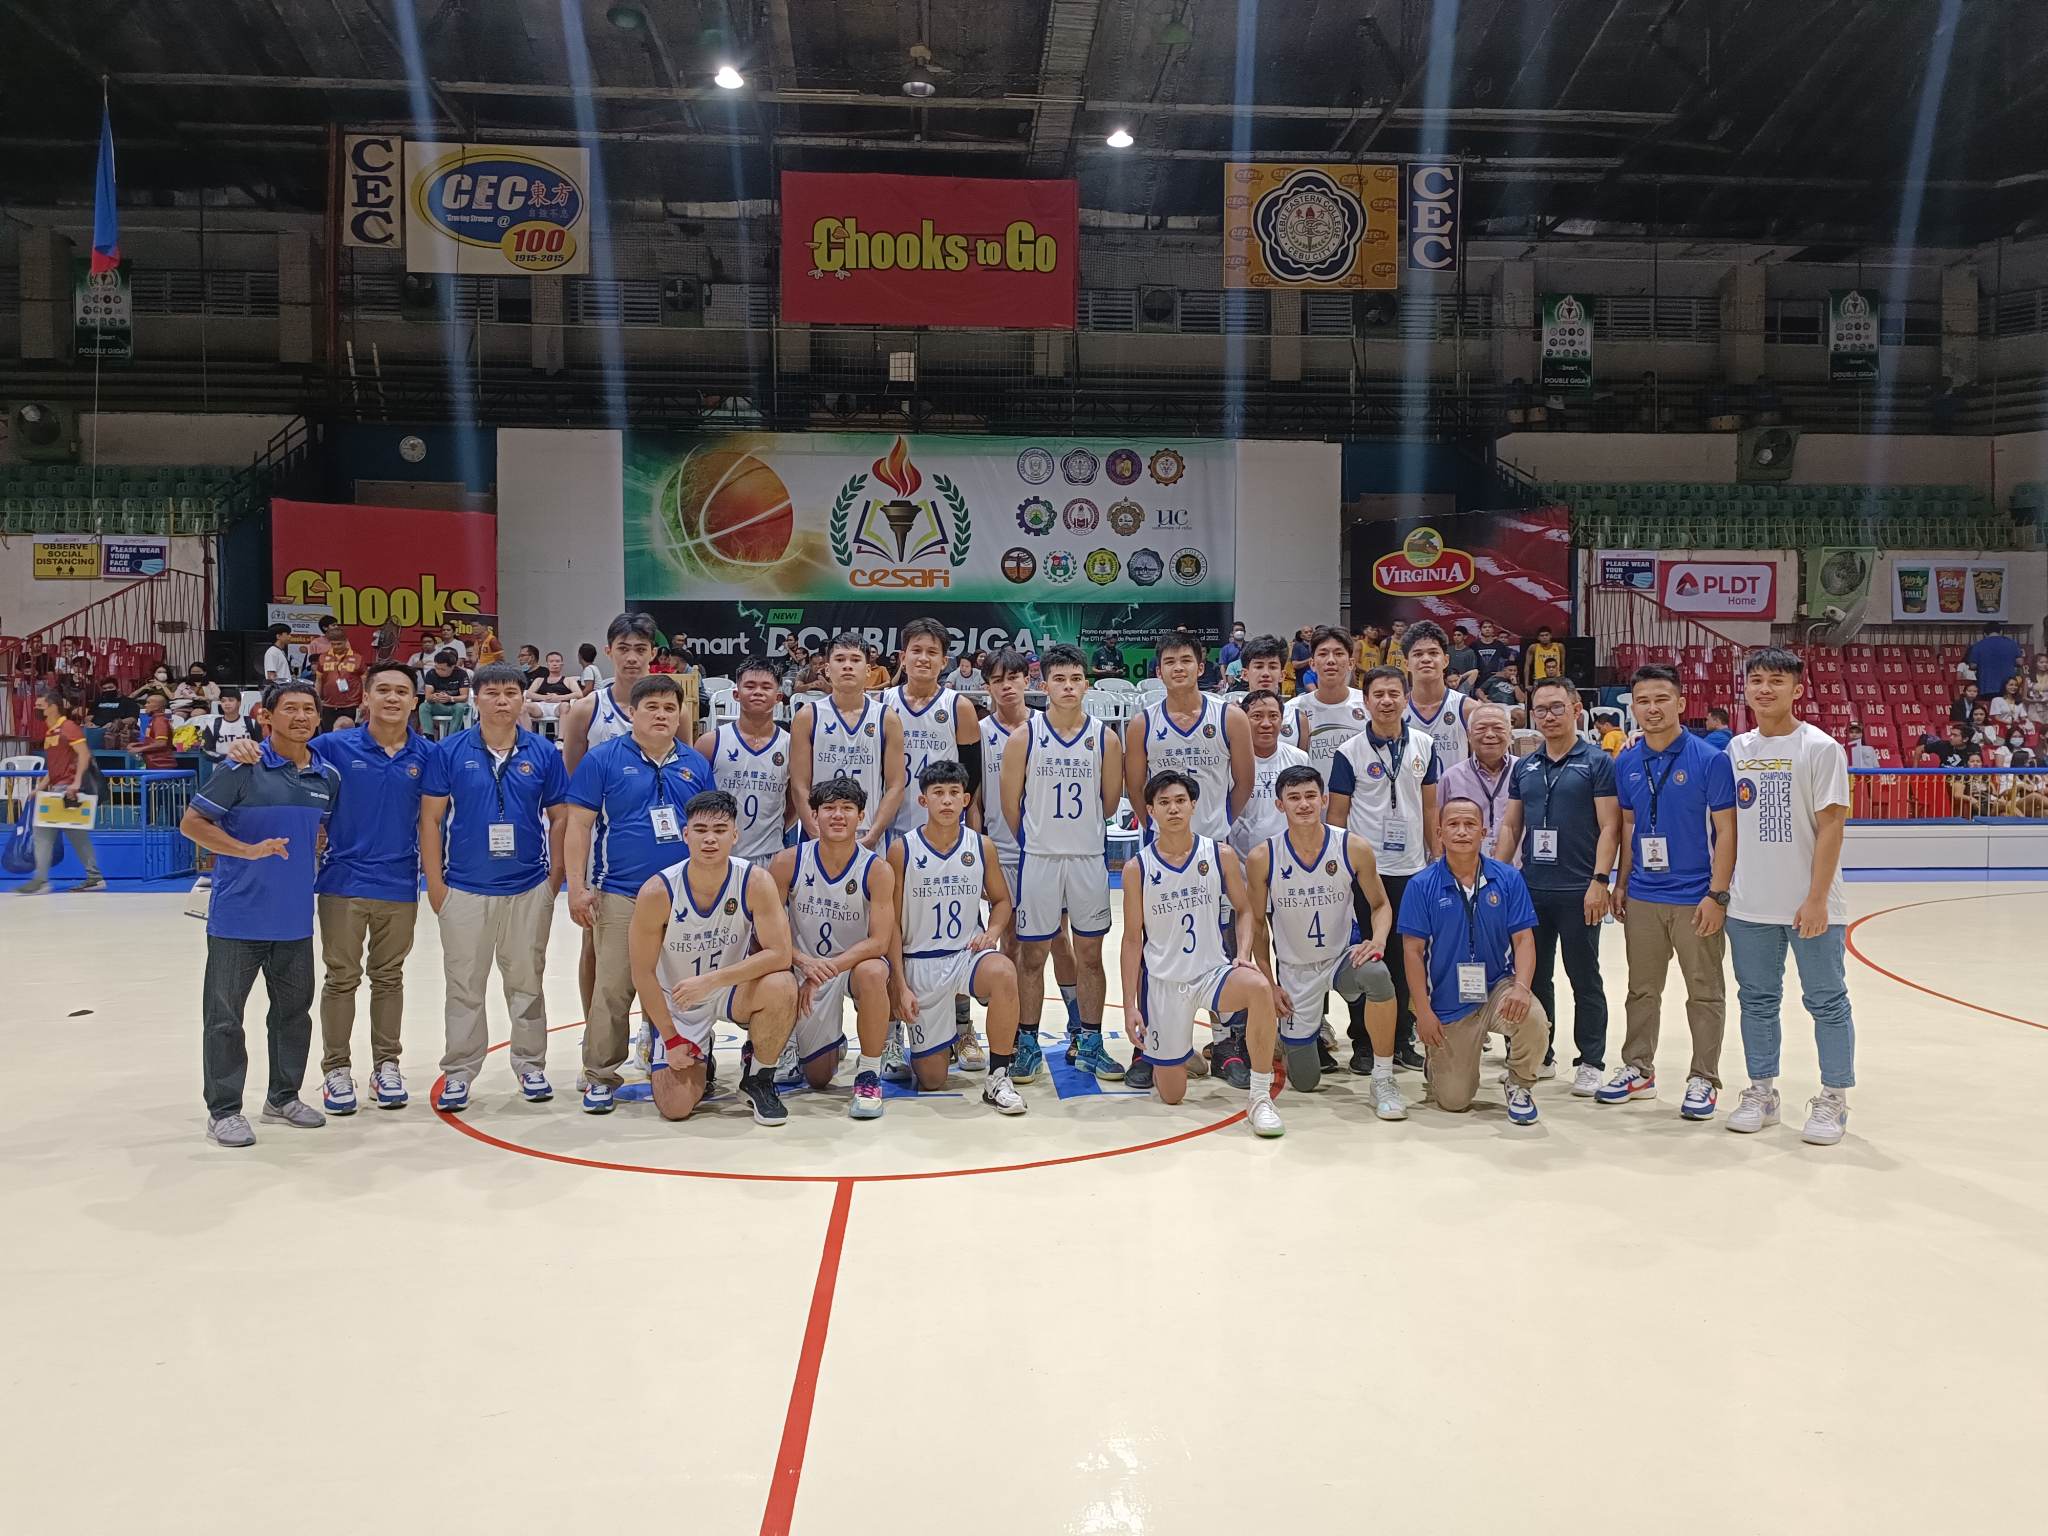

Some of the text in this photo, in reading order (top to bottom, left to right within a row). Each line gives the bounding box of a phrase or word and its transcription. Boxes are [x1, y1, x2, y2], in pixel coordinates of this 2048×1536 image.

[351, 138, 394, 244] CEC
[442, 174, 528, 210] CEC
[528, 180, 573, 207] 東方
[1279, 195, 1341, 239] CEBU EASTERN COLLEGE
[1412, 167, 1455, 268] CEC
[513, 229, 565, 253] 100
[813, 217, 1057, 273] Chooks to Go
[515, 254, 564, 262] 1915-2015
[1288, 246, 1331, 260] CEBU CITY
[1378, 561, 1466, 586] VIRGINIA
[1703, 576, 1760, 594] PLDT
[1728, 596, 1756, 605] Home
[772, 612, 798, 620] NEW!
[683, 632, 750, 655] mart
[767, 627, 901, 657] DOBL
[1156, 756, 1220, 768] SHS-ATENEO
[1035, 766, 1093, 778] SHS-ATENE
[1760, 772, 1792, 781] CHAMPIONS
[722, 778, 784, 793] SHS-ATENEO
[1760, 781, 1791, 794] 2012
[1052, 782, 1083, 819] 13
[1760, 794, 1791, 806] 2014
[743, 794, 758, 831] 9
[1760, 806, 1791, 818] 2015
[1760, 818, 1791, 830] 2016
[1760, 830, 1791, 842] 2019
[912, 884, 978, 898] SHS-ATENEO
[1277, 891, 1345, 908] SHS-ATENEO
[797, 903, 860, 921] SHS-ATENEO
[931, 900, 962, 940] 18
[1017, 910, 1027, 929] 13
[1181, 913, 1196, 954] 3
[1307, 911, 1326, 947] 4
[669, 933, 738, 953] SHS-ATENEO
[816, 922, 832, 957] 8
[1286, 1014, 1295, 1031] 4
[909, 1024, 925, 1046] 18
[1151, 1030, 1160, 1051] 3
